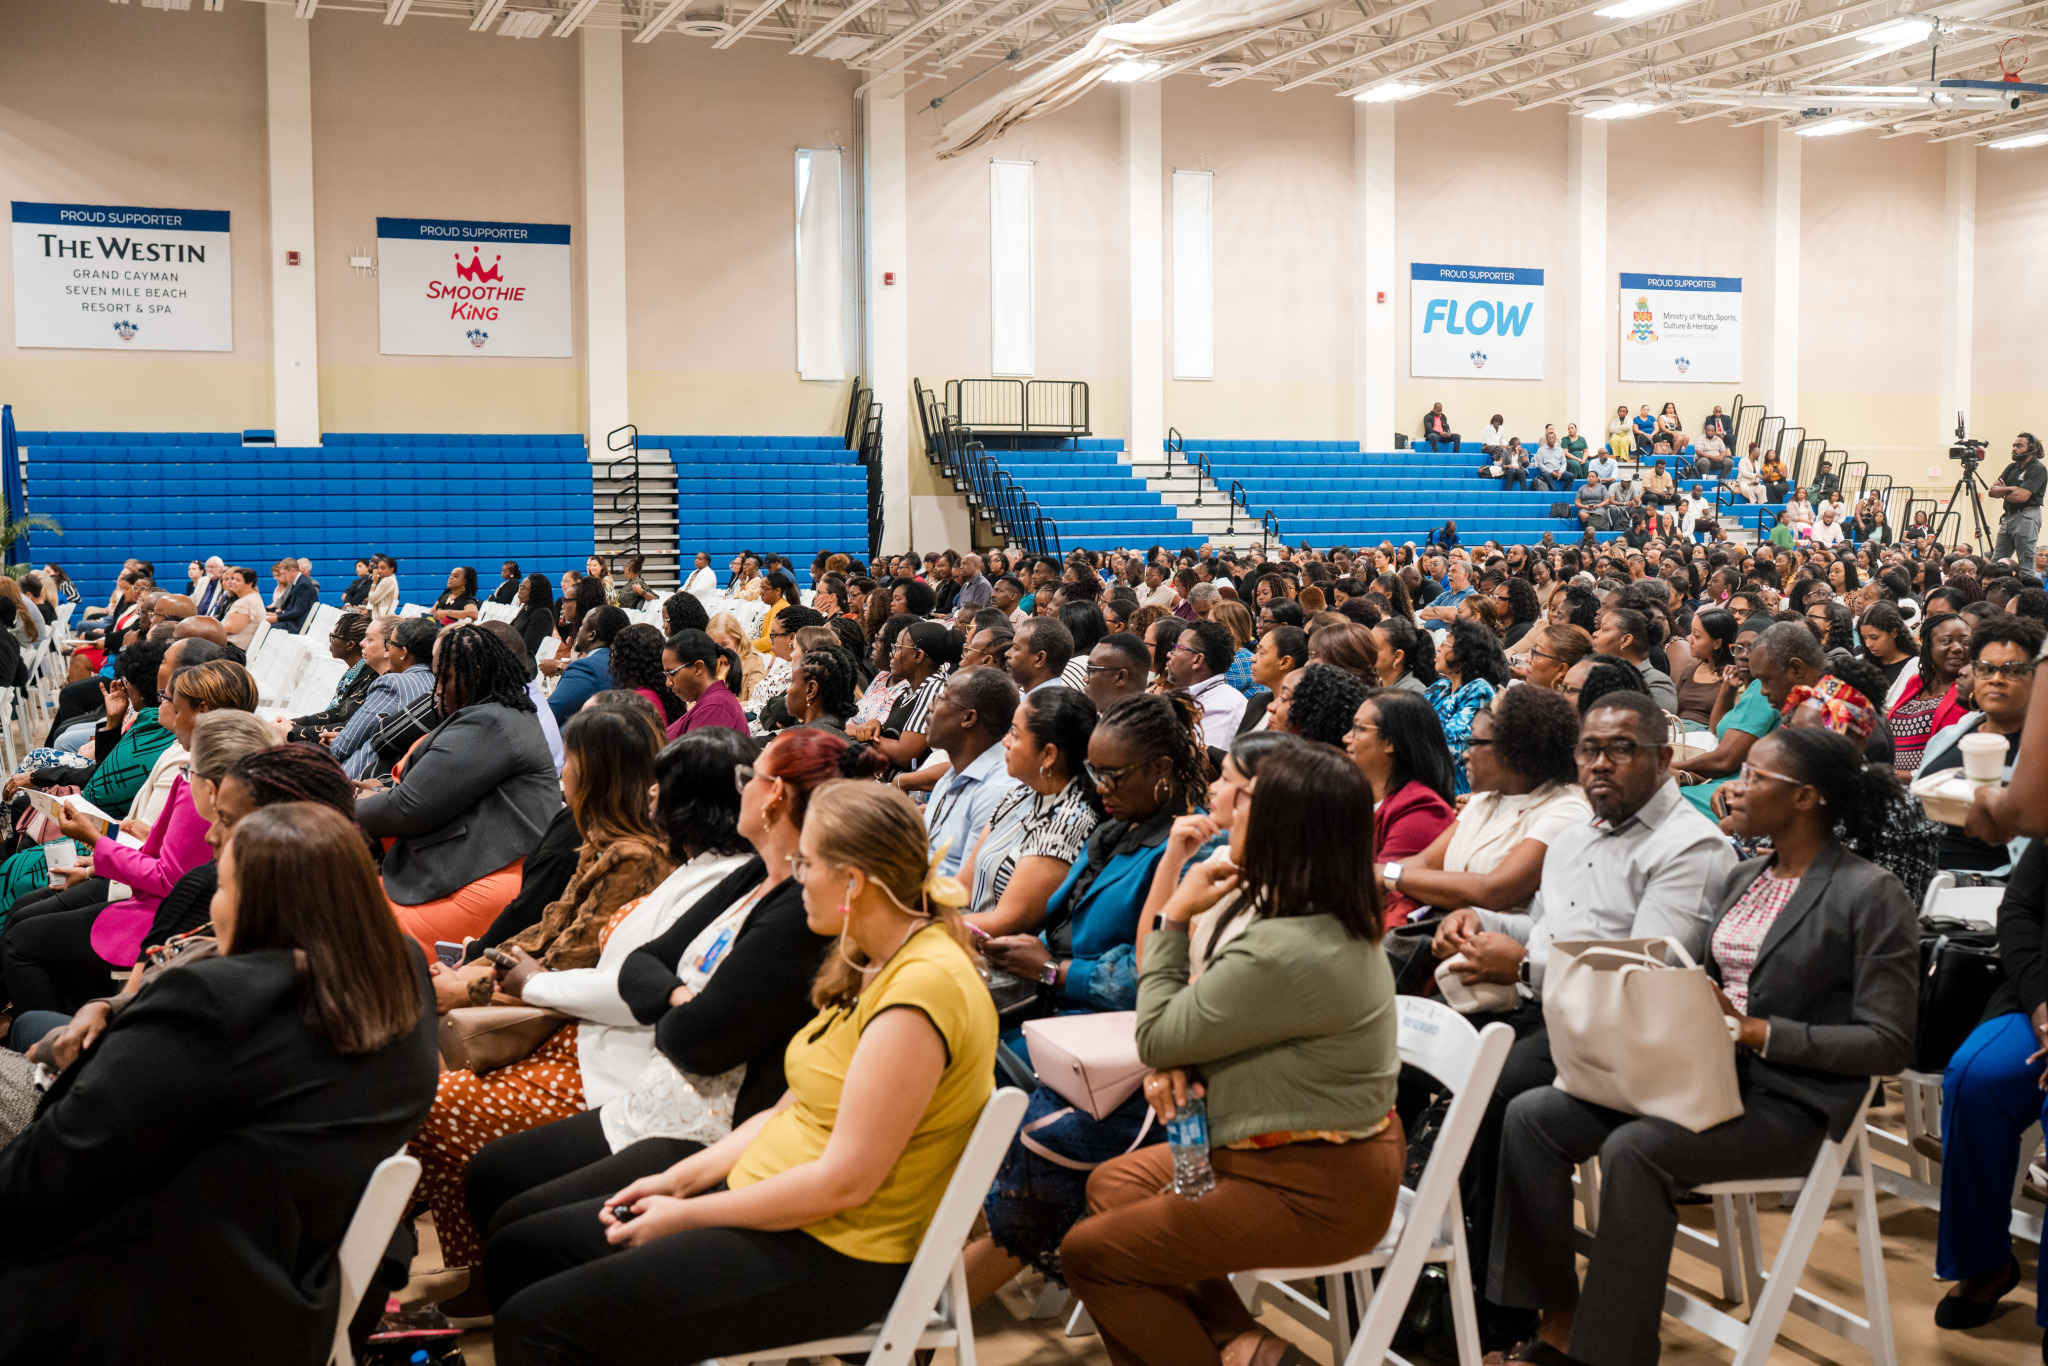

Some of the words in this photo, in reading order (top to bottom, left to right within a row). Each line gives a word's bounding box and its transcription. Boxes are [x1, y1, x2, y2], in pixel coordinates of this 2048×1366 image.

[60, 210, 106, 223] PROUD
[108, 212, 183, 226] SUPPORTER
[420, 225, 460, 237] PROUD
[462, 227, 528, 239] SUPPORTER
[37, 233, 94, 259] THE
[96, 236, 206, 263] WESTIN
[73, 269, 120, 280] GRAND
[124, 271, 179, 282] CAYMAN
[1440, 269, 1468, 279] PROUD
[1469, 271, 1515, 281] SUPPORTER
[1647, 278, 1673, 287] PROUD
[1674, 279, 1717, 289] SUPPORTER
[65, 285, 107, 296] SEVEN
[111, 287, 141, 297] MILE
[145, 288, 187, 298] BEACH
[426, 280, 526, 301] SMOOTHIE
[81, 302, 131, 313] RESORT
[136, 303, 144, 314] &
[149, 304, 172, 314] SPA
[1423, 298, 1534, 337] FLOW
[1663, 312, 1689, 321] Ministry
[1696, 313, 1715, 321] Youth,
[1715, 314, 1738, 322] Sports,
[1663, 322, 1686, 330] Culture
[1687, 322, 1692, 330] &
[1692, 323, 1719, 332] Heritage
